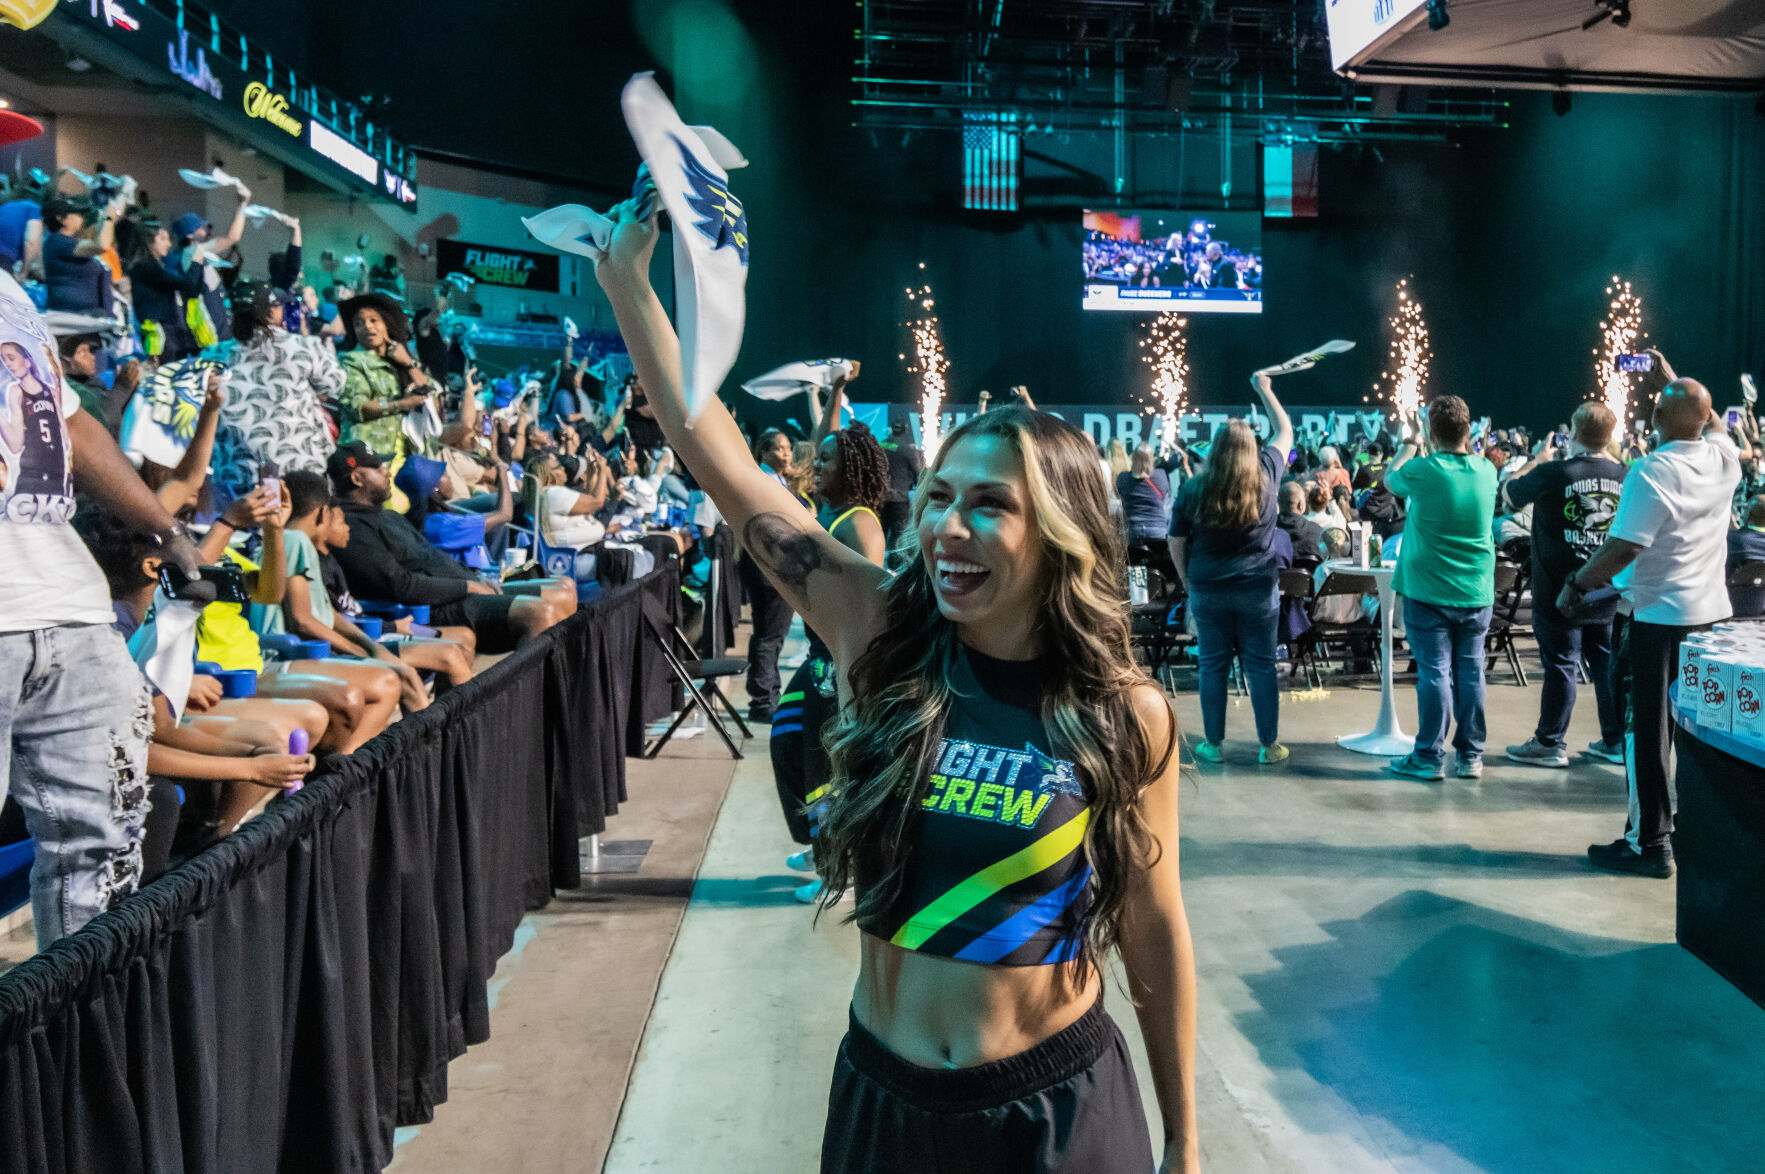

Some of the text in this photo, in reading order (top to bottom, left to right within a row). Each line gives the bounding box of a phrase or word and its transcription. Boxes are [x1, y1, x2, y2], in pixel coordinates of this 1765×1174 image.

[465, 249, 521, 270] FLIGHT
[483, 267, 530, 286] CREW
[38, 418, 52, 443] 5
[1683, 663, 1699, 676] POP
[1702, 679, 1719, 693] POP
[1704, 690, 1725, 704] CORN
[1736, 687, 1753, 702] POP
[1739, 698, 1760, 714] CORN
[922, 774, 1051, 826] CREW
